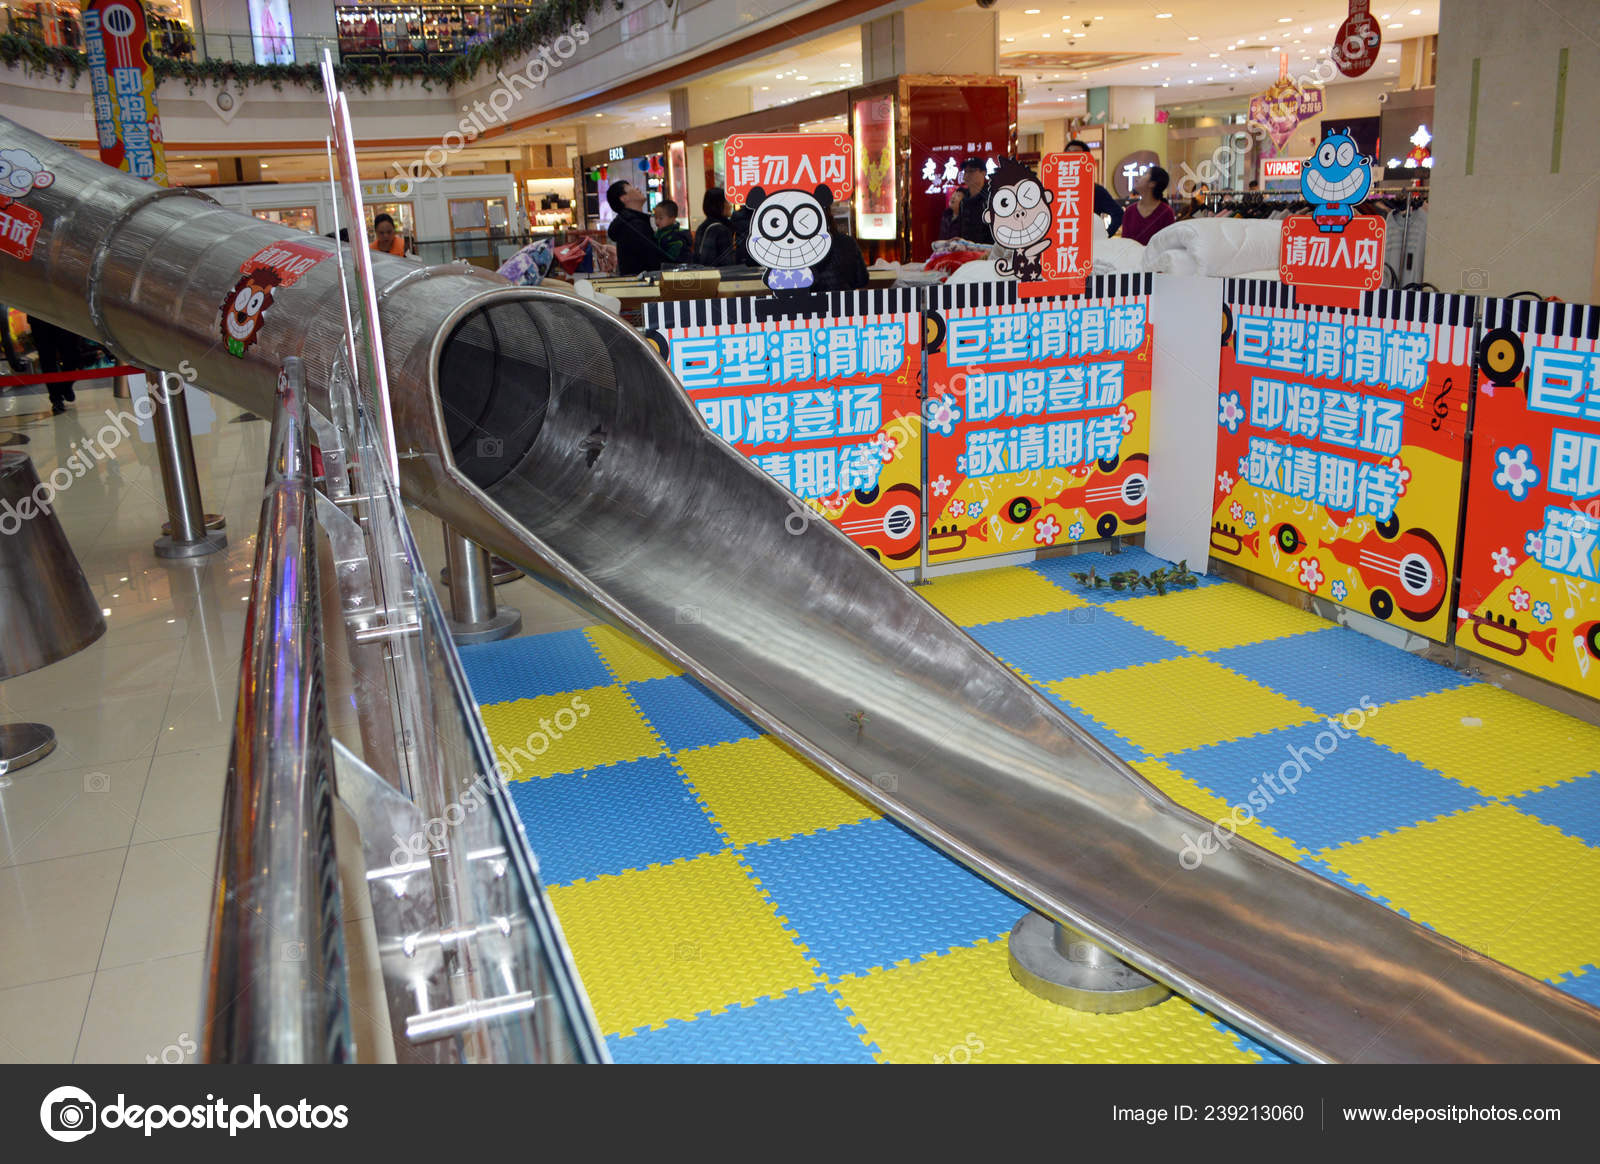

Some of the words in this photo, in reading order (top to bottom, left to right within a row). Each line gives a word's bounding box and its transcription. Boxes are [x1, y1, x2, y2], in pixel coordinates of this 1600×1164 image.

[113, 67, 155, 178] 即将登场
[1266, 161, 1299, 175] VIPABC
[1056, 160, 1080, 273] 暂未开放
[671, 323, 905, 389] 巨型滑滑梯
[947, 304, 1146, 367] 巨型滑滑梯
[1236, 314, 1430, 392] 巨型滑滑梯
[696, 384, 882, 446] 即将登场
[965, 361, 1125, 423] 即将登场
[1251, 376, 1404, 458] 即将登场
[965, 415, 1125, 478] 敬请期待
[1248, 436, 1401, 523] 敬请期待
